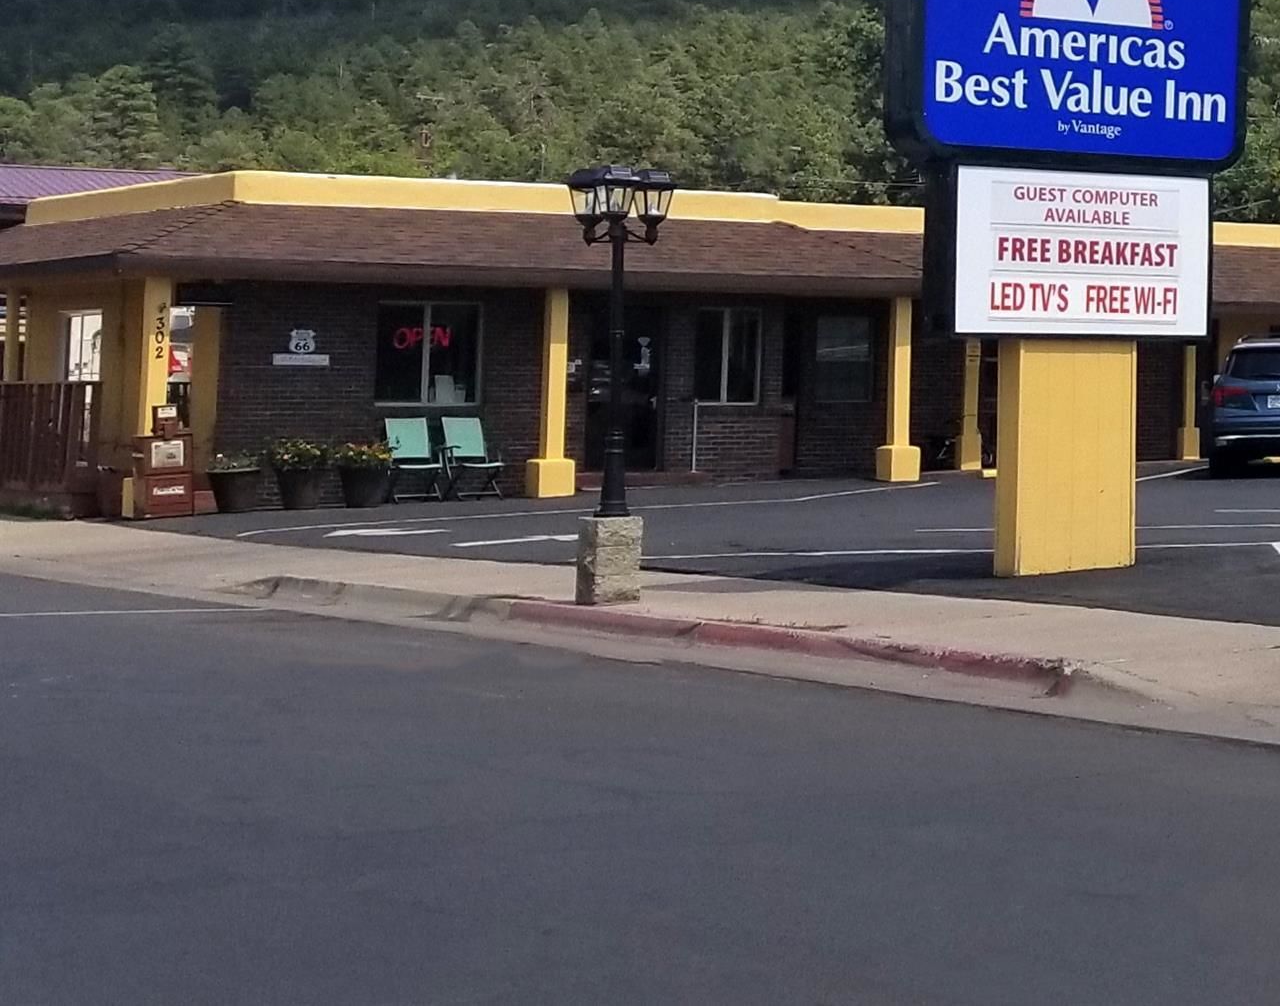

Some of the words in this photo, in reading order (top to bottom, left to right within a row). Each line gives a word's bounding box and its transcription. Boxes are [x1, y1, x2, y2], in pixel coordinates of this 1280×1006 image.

[983, 12, 1185, 70] Americas
[935, 60, 1028, 109] Best
[1040, 68, 1152, 118] Value
[1165, 80, 1226, 123] Inn
[1057, 120, 1071, 135] by
[1071, 119, 1122, 139] Vantage
[1013, 186, 1067, 203] GUEST
[1072, 189, 1158, 207] COMPUTER
[1044, 208, 1130, 225] AVAILABLE
[998, 237, 1051, 262] FREE
[1058, 239, 1178, 267] BREAKFAST
[990, 282, 1025, 311] LED
[1029, 283, 1069, 313] TV'S
[1085, 285, 1131, 314] FREE
[1134, 286, 1177, 315] WI-FI
[294, 341, 310, 352] 66
